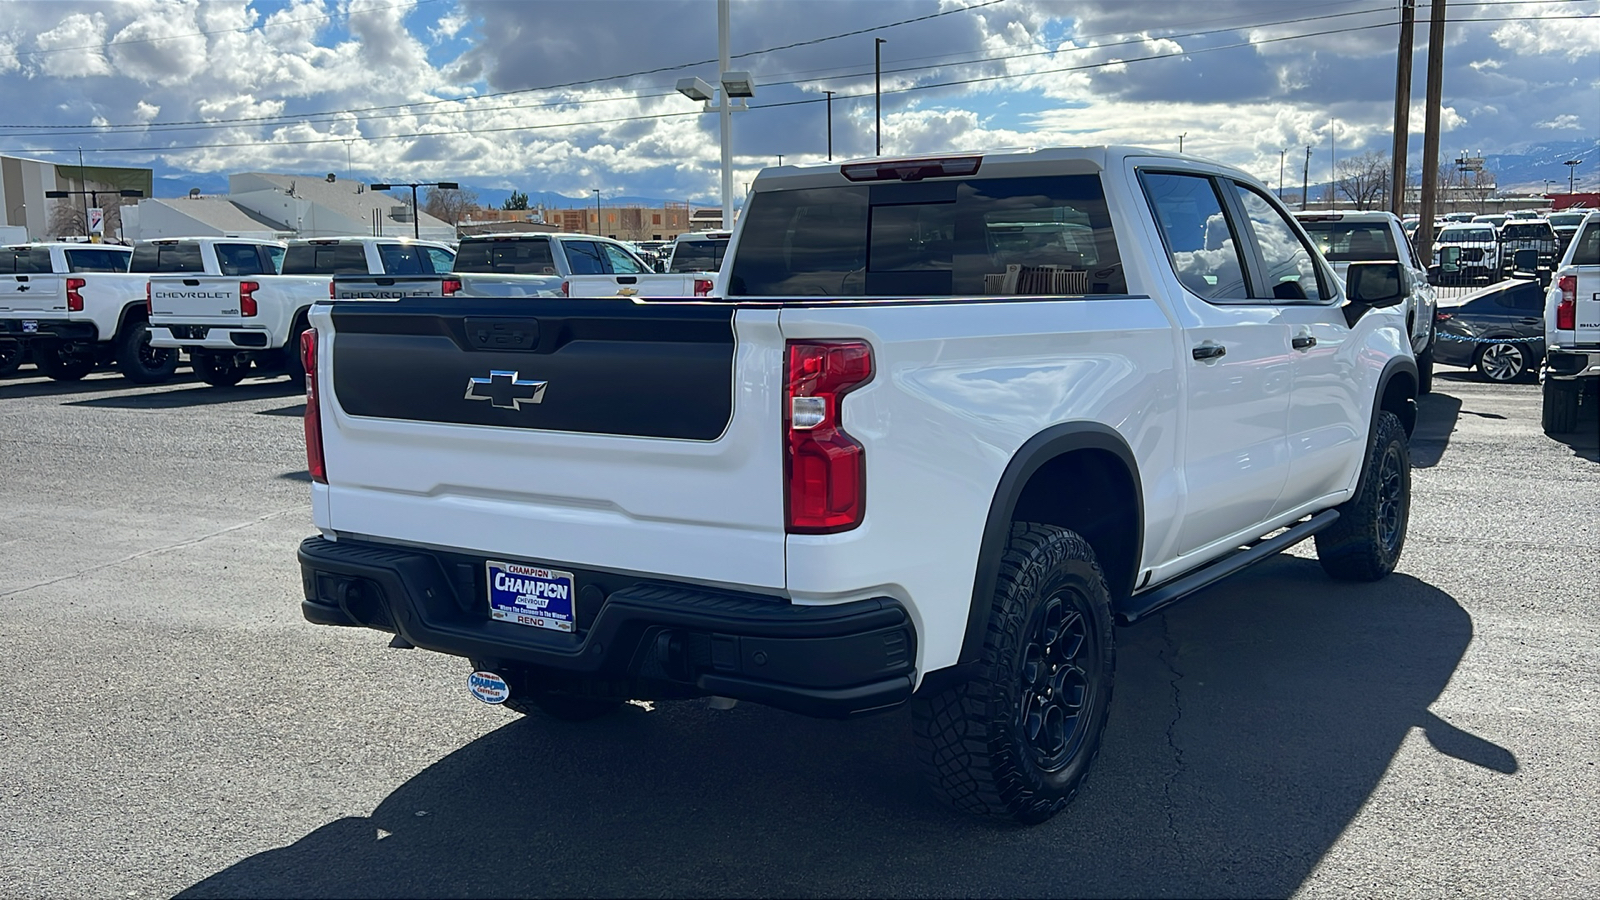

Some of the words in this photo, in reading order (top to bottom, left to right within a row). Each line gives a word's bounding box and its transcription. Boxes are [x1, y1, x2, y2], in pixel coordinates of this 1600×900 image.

[508, 565, 549, 578] CHAMPION
[494, 572, 568, 600] CHAMPION
[517, 596, 547, 606] CHEVROLET
[517, 615, 544, 627] RENO
